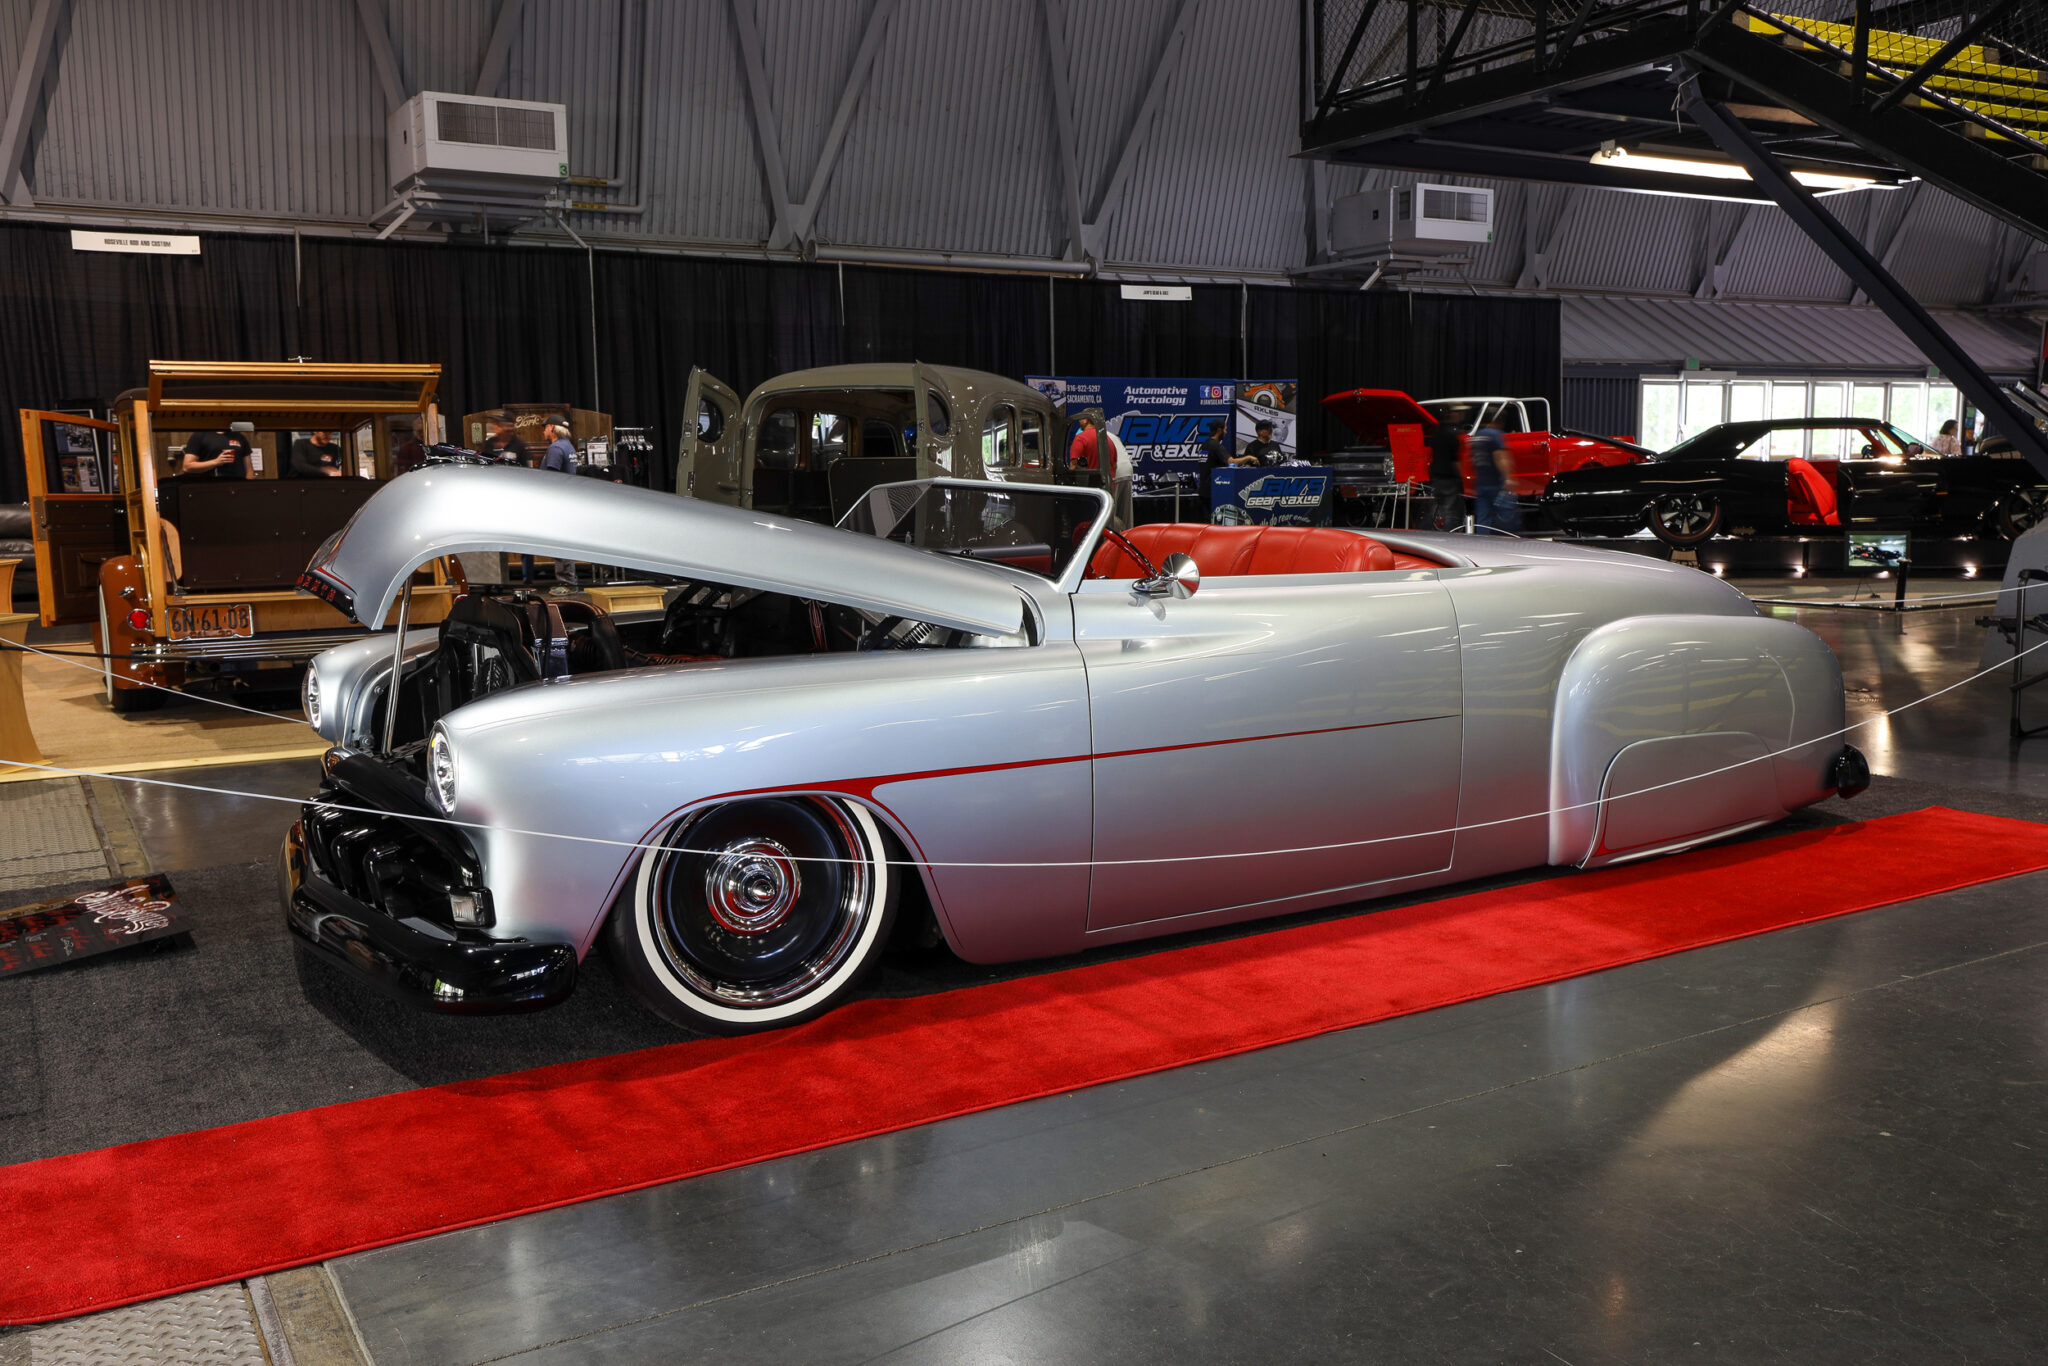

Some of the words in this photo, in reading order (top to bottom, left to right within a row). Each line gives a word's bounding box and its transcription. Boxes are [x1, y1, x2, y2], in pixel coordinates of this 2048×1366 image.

[560, 164, 568, 176] 3
[1124, 386, 1188, 395] Automotive
[1126, 395, 1186, 406] Proctology
